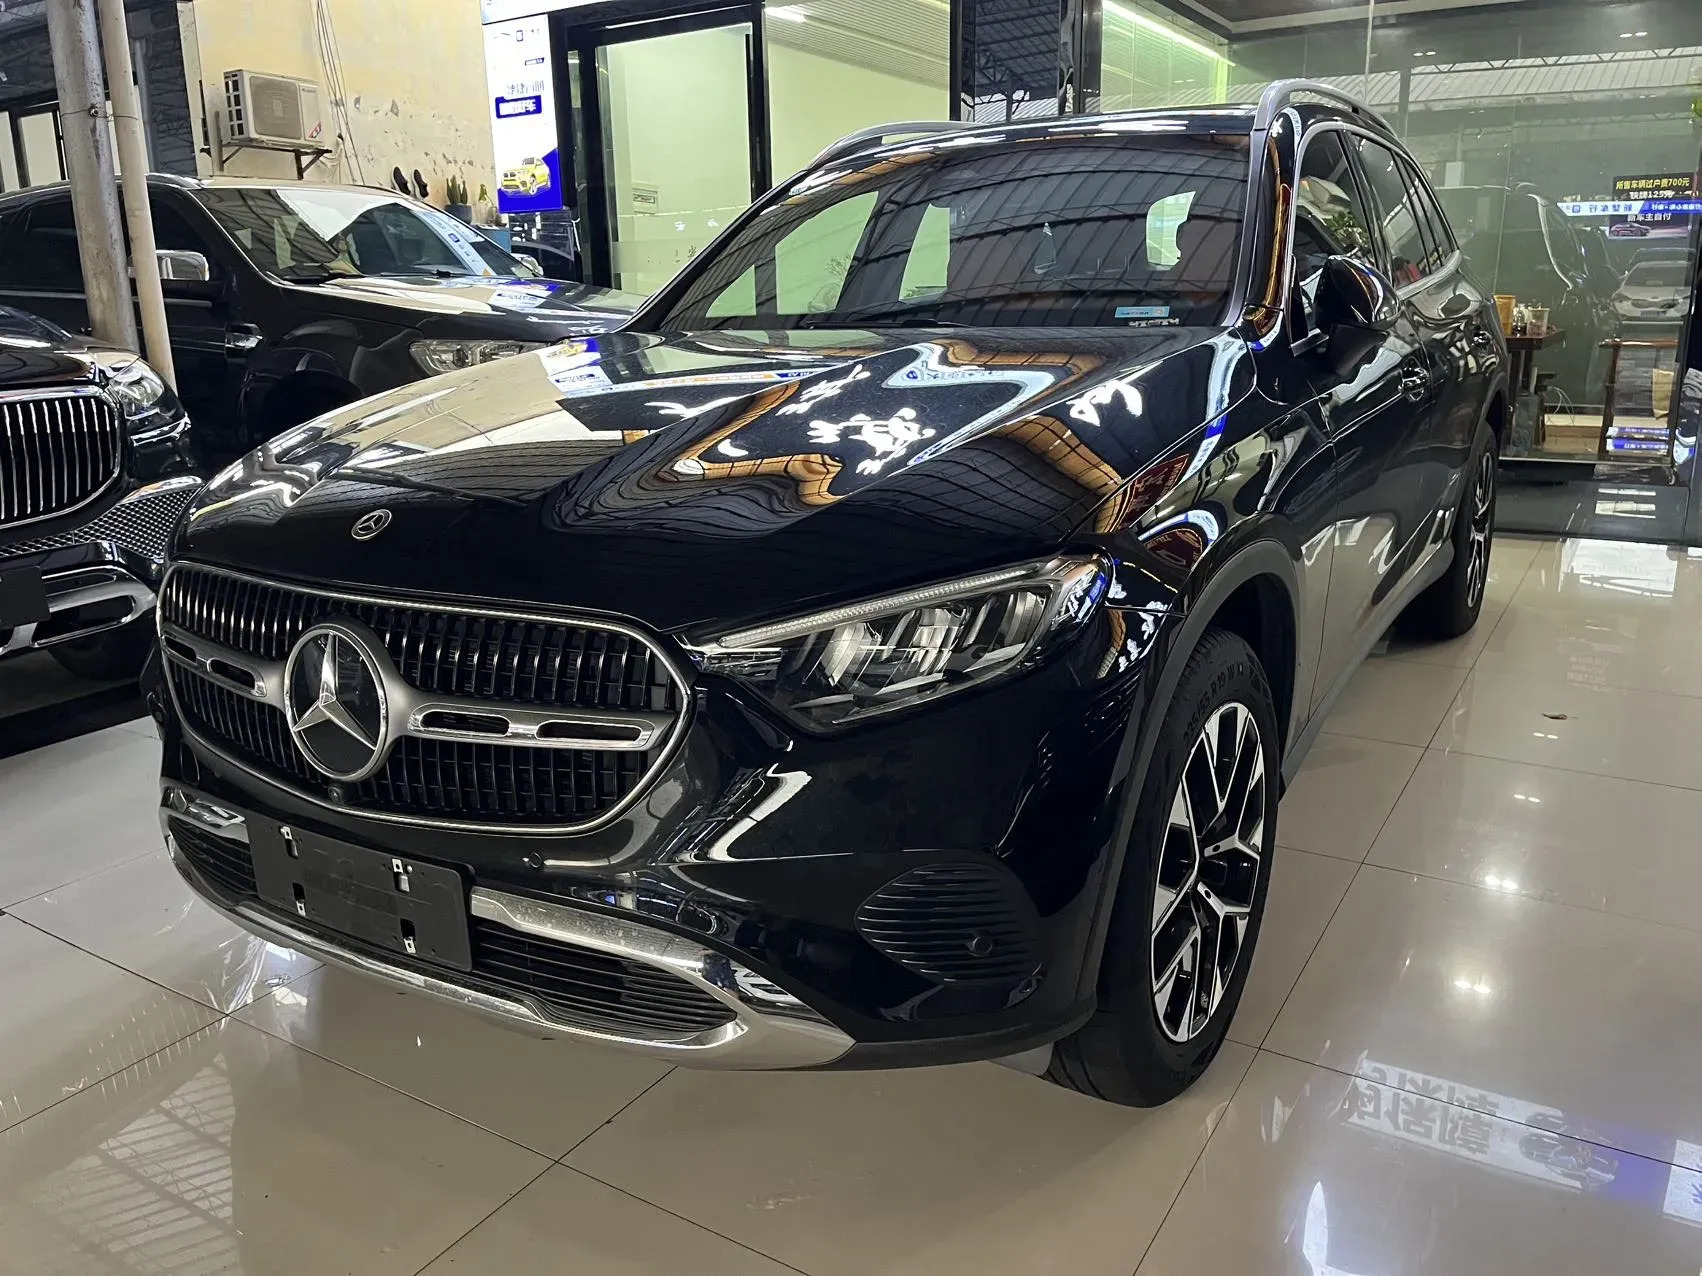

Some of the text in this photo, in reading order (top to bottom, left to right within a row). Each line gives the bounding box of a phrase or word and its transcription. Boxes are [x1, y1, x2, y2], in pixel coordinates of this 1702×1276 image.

[1615, 177, 1690, 190] 所售车辆过户费700元
